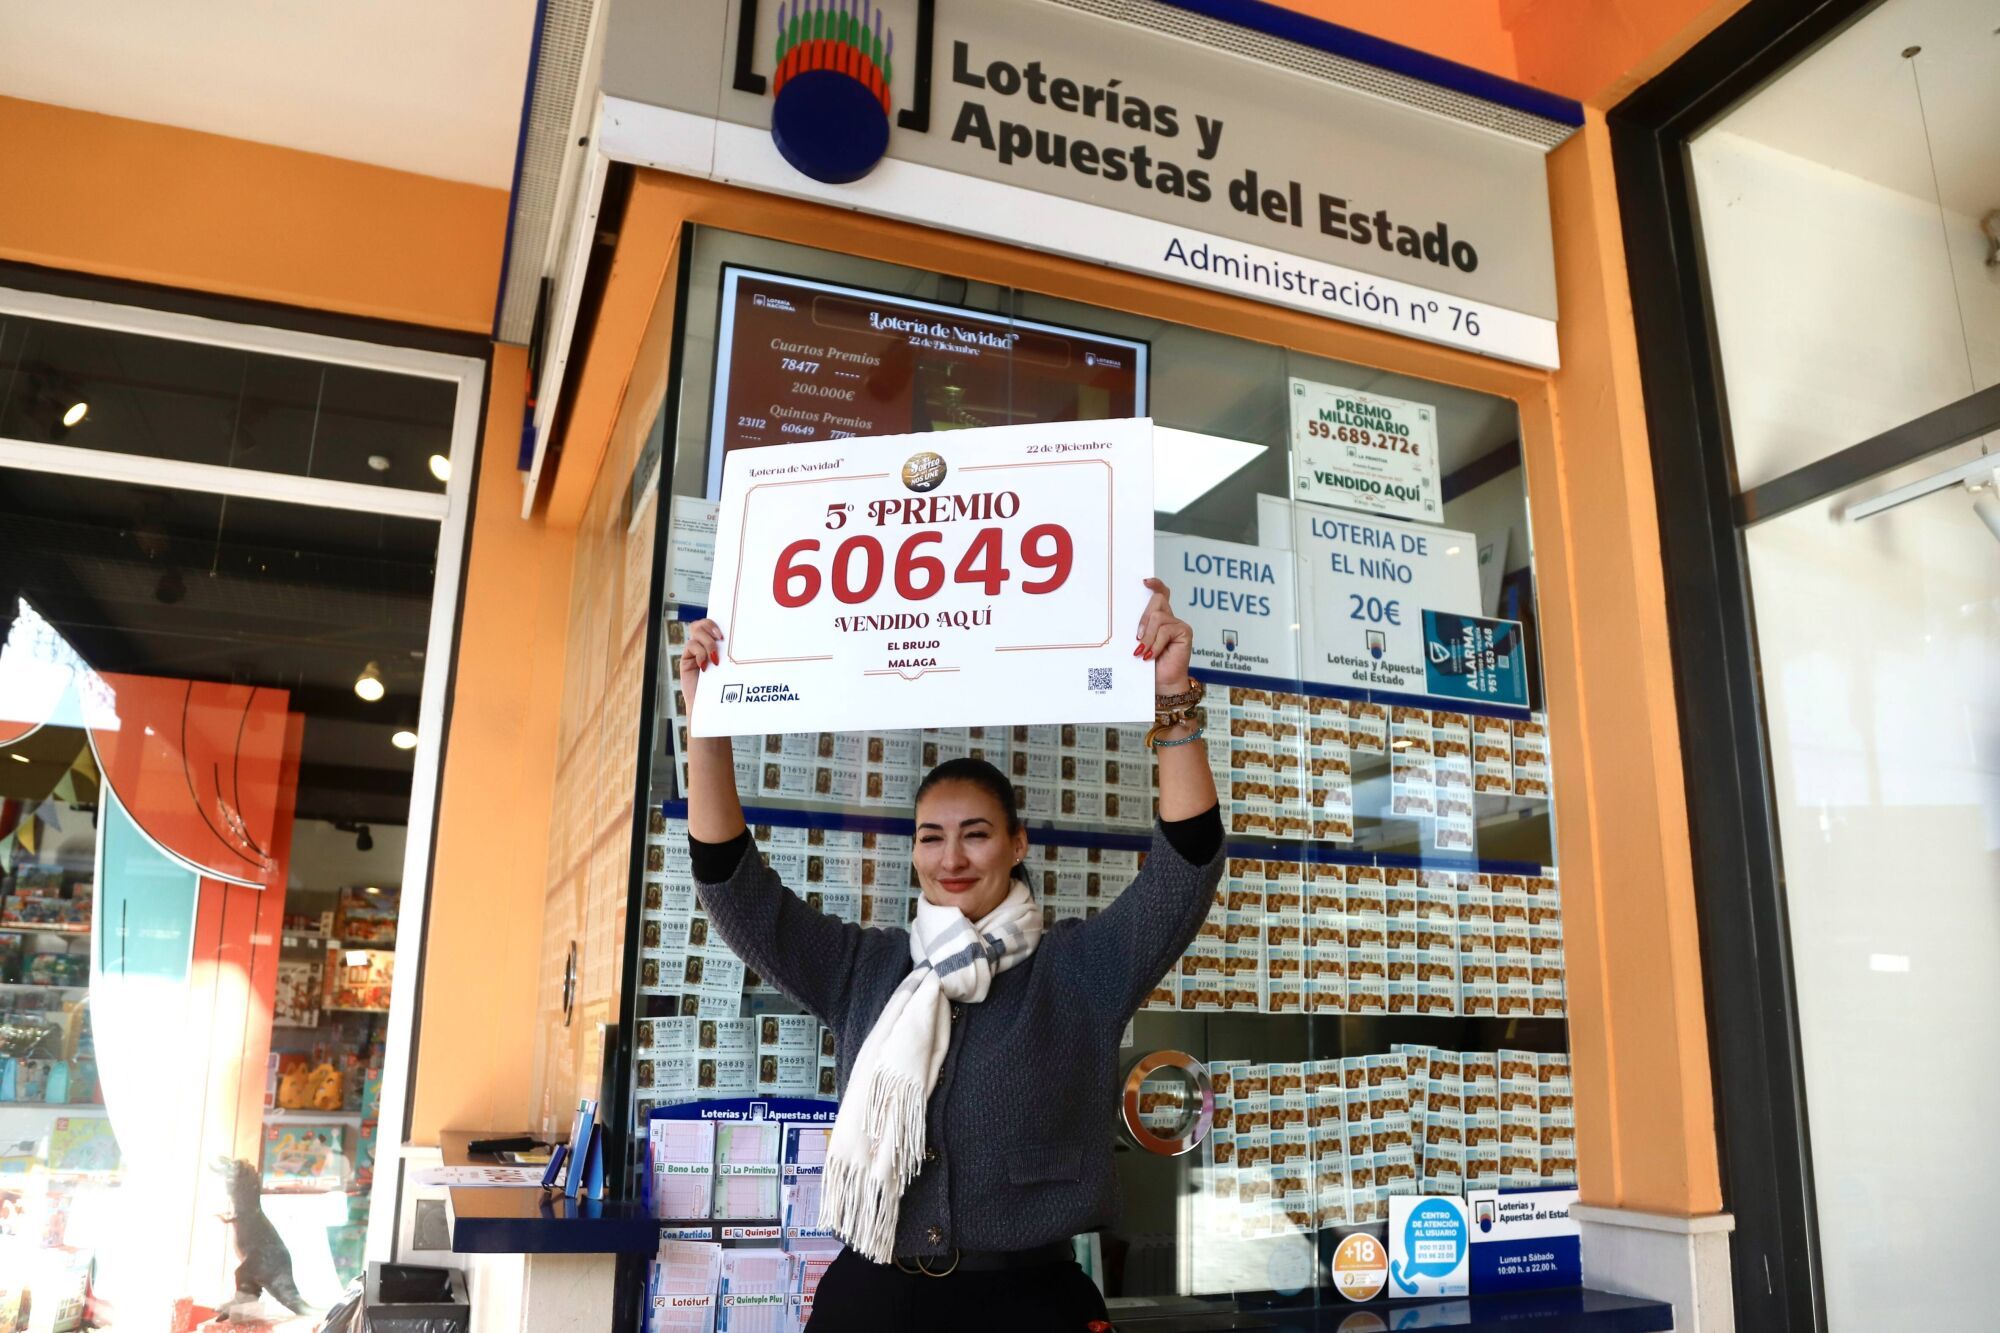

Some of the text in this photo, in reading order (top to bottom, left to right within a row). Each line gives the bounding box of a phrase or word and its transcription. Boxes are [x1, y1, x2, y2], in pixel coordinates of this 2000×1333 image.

[952, 40, 1223, 160] Loterías y
[951, 101, 1478, 273] Apuestas del Estado
[1164, 236, 1400, 317] Administración
[1448, 306, 1481, 338] 76
[909, 335, 920, 345] 22
[931, 323, 950, 338] de
[952, 326, 1019, 350] Navidad
[770, 337, 880, 366] Cuartos Premios
[781, 357, 820, 375] 78477
[791, 381, 856, 401] 200.000€
[769, 404, 873, 430] Quintos Premios
[1336, 399, 1392, 421] PREMIO
[738, 416, 767, 429] 23112
[781, 422, 815, 436] 60649
[1319, 408, 1410, 437] MILLONARIO
[1026, 441, 1113, 454] 22 de Diciembre
[787, 465, 799, 473] de
[800, 458, 844, 472] Navidad
[1314, 470, 1381, 494] VENDIDO
[1384, 485, 1420, 501] AQUÍ
[868, 491, 1020, 527] PREMIO
[1311, 517, 1428, 556] LOTERIA DE
[772, 523, 1074, 609] 60649
[1184, 551, 1275, 585] LOTERIA
[1331, 553, 1413, 585] EL NIÑO
[1189, 586, 1271, 617] JUEVES
[1350, 594, 1402, 626] 20€
[834, 605, 992, 633] VENDIDO AQUÍ
[887, 640, 941, 651] EL BRUJO
[888, 658, 937, 668] MALAGA
[1226, 653, 1232, 661] y
[1232, 651, 1269, 665] Apuestas
[1462, 626, 1479, 691] ALARMA
[1483, 628, 1498, 693] 951 453 248
[1210, 659, 1252, 672] del Estado
[1371, 660, 1378, 671] y
[1352, 669, 1405, 686] del Estado
[746, 683, 790, 694] LOTERÍA
[745, 692, 800, 703] NACIONAL
[705, 959, 733, 969] 41779
[700, 997, 728, 1006] 41779
[655, 1019, 683, 1027] 48072
[655, 1059, 683, 1067] 48072
[741, 1111, 748, 1121] y
[769, 1110, 811, 1121] Apuestas
[813, 1112, 827, 1120] del
[668, 1165, 709, 1174] Bono Loto
[733, 1165, 776, 1174] La Primitiva
[1530, 1202, 1535, 1211] y
[1421, 1211, 1451, 1219] CENTRO
[1499, 1212, 1533, 1224] Apuestas
[1535, 1211, 1547, 1220] del
[1412, 1219, 1459, 1228] DE ATENCIÓN
[662, 1229, 712, 1239] Con Partidos
[745, 1228, 779, 1238] Quinigol
[1414, 1229, 1457, 1237] AL USUARIO
[1344, 1240, 1375, 1262] +18
[1499, 1256, 1521, 1264] Lunes
[1528, 1252, 1554, 1262] Sábado
[1498, 1265, 1517, 1275] 10:00
[769, 1294, 783, 1303] Plus
